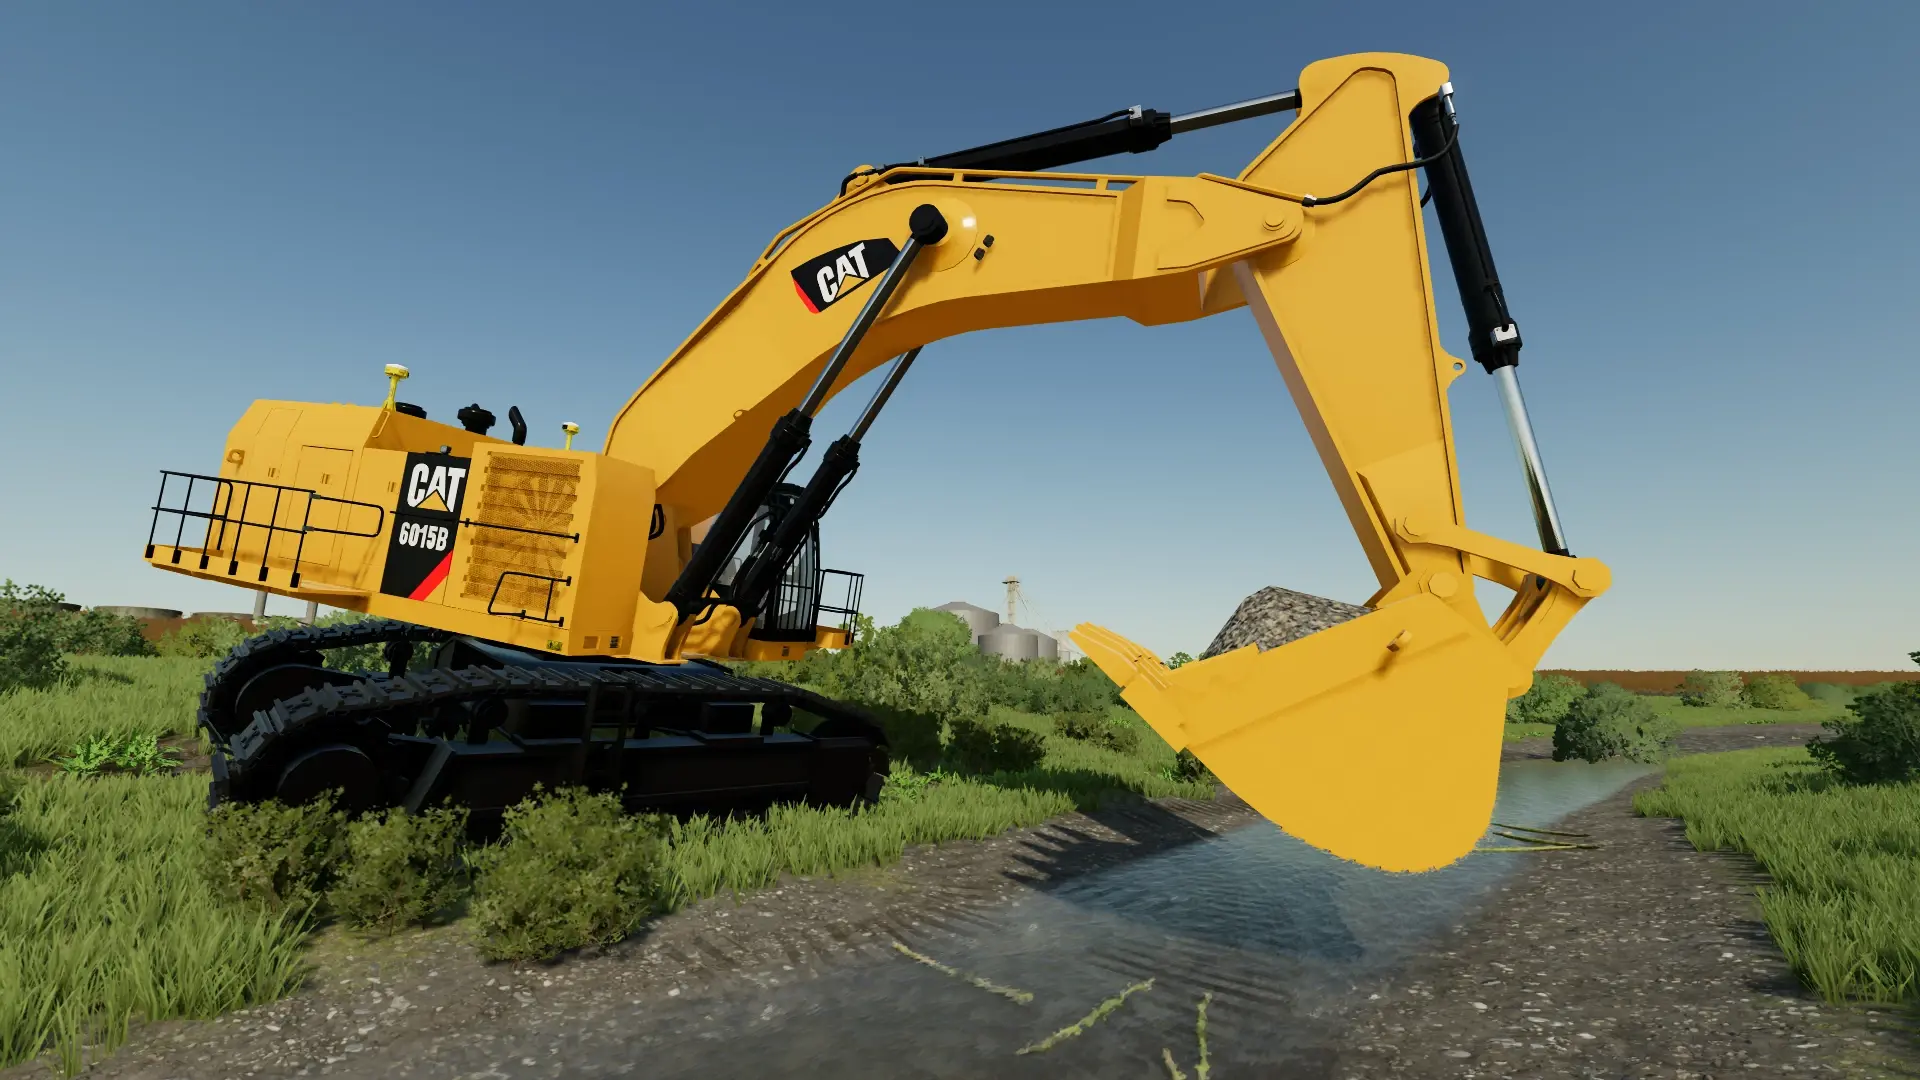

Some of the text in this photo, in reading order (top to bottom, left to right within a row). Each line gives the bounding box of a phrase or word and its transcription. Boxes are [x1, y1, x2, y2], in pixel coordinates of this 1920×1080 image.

[816, 242, 870, 303] CAT
[406, 462, 467, 513] CAT
[398, 521, 449, 552] 6015B
